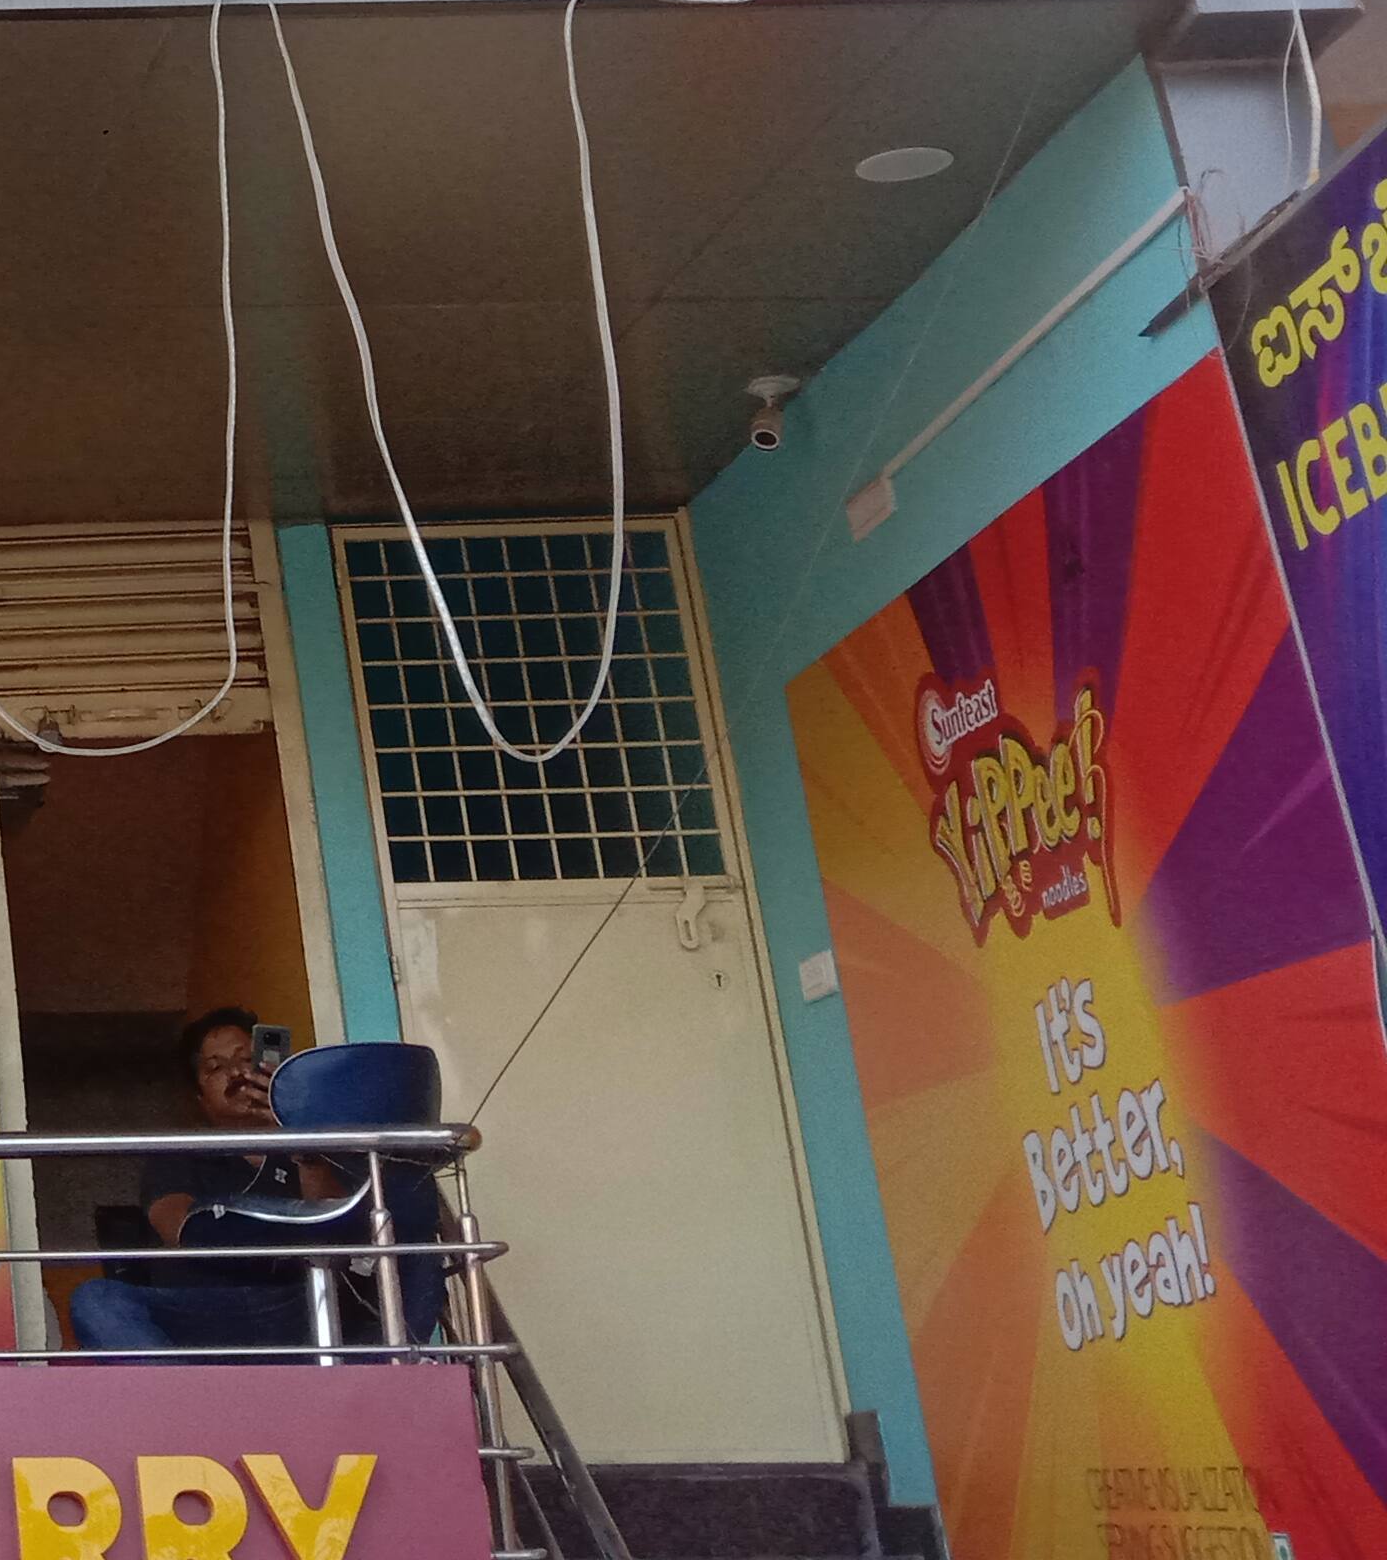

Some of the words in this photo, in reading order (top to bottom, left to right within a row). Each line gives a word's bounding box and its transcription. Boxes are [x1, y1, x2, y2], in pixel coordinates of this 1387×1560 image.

[1276, 383, 1387, 551] ICEB
[929, 677, 999, 747] Sunfeast
[1041, 868, 1088, 911] noodles
[1035, 977, 1107, 1094] It's
[1107, 1202, 1217, 1341] yeah!
